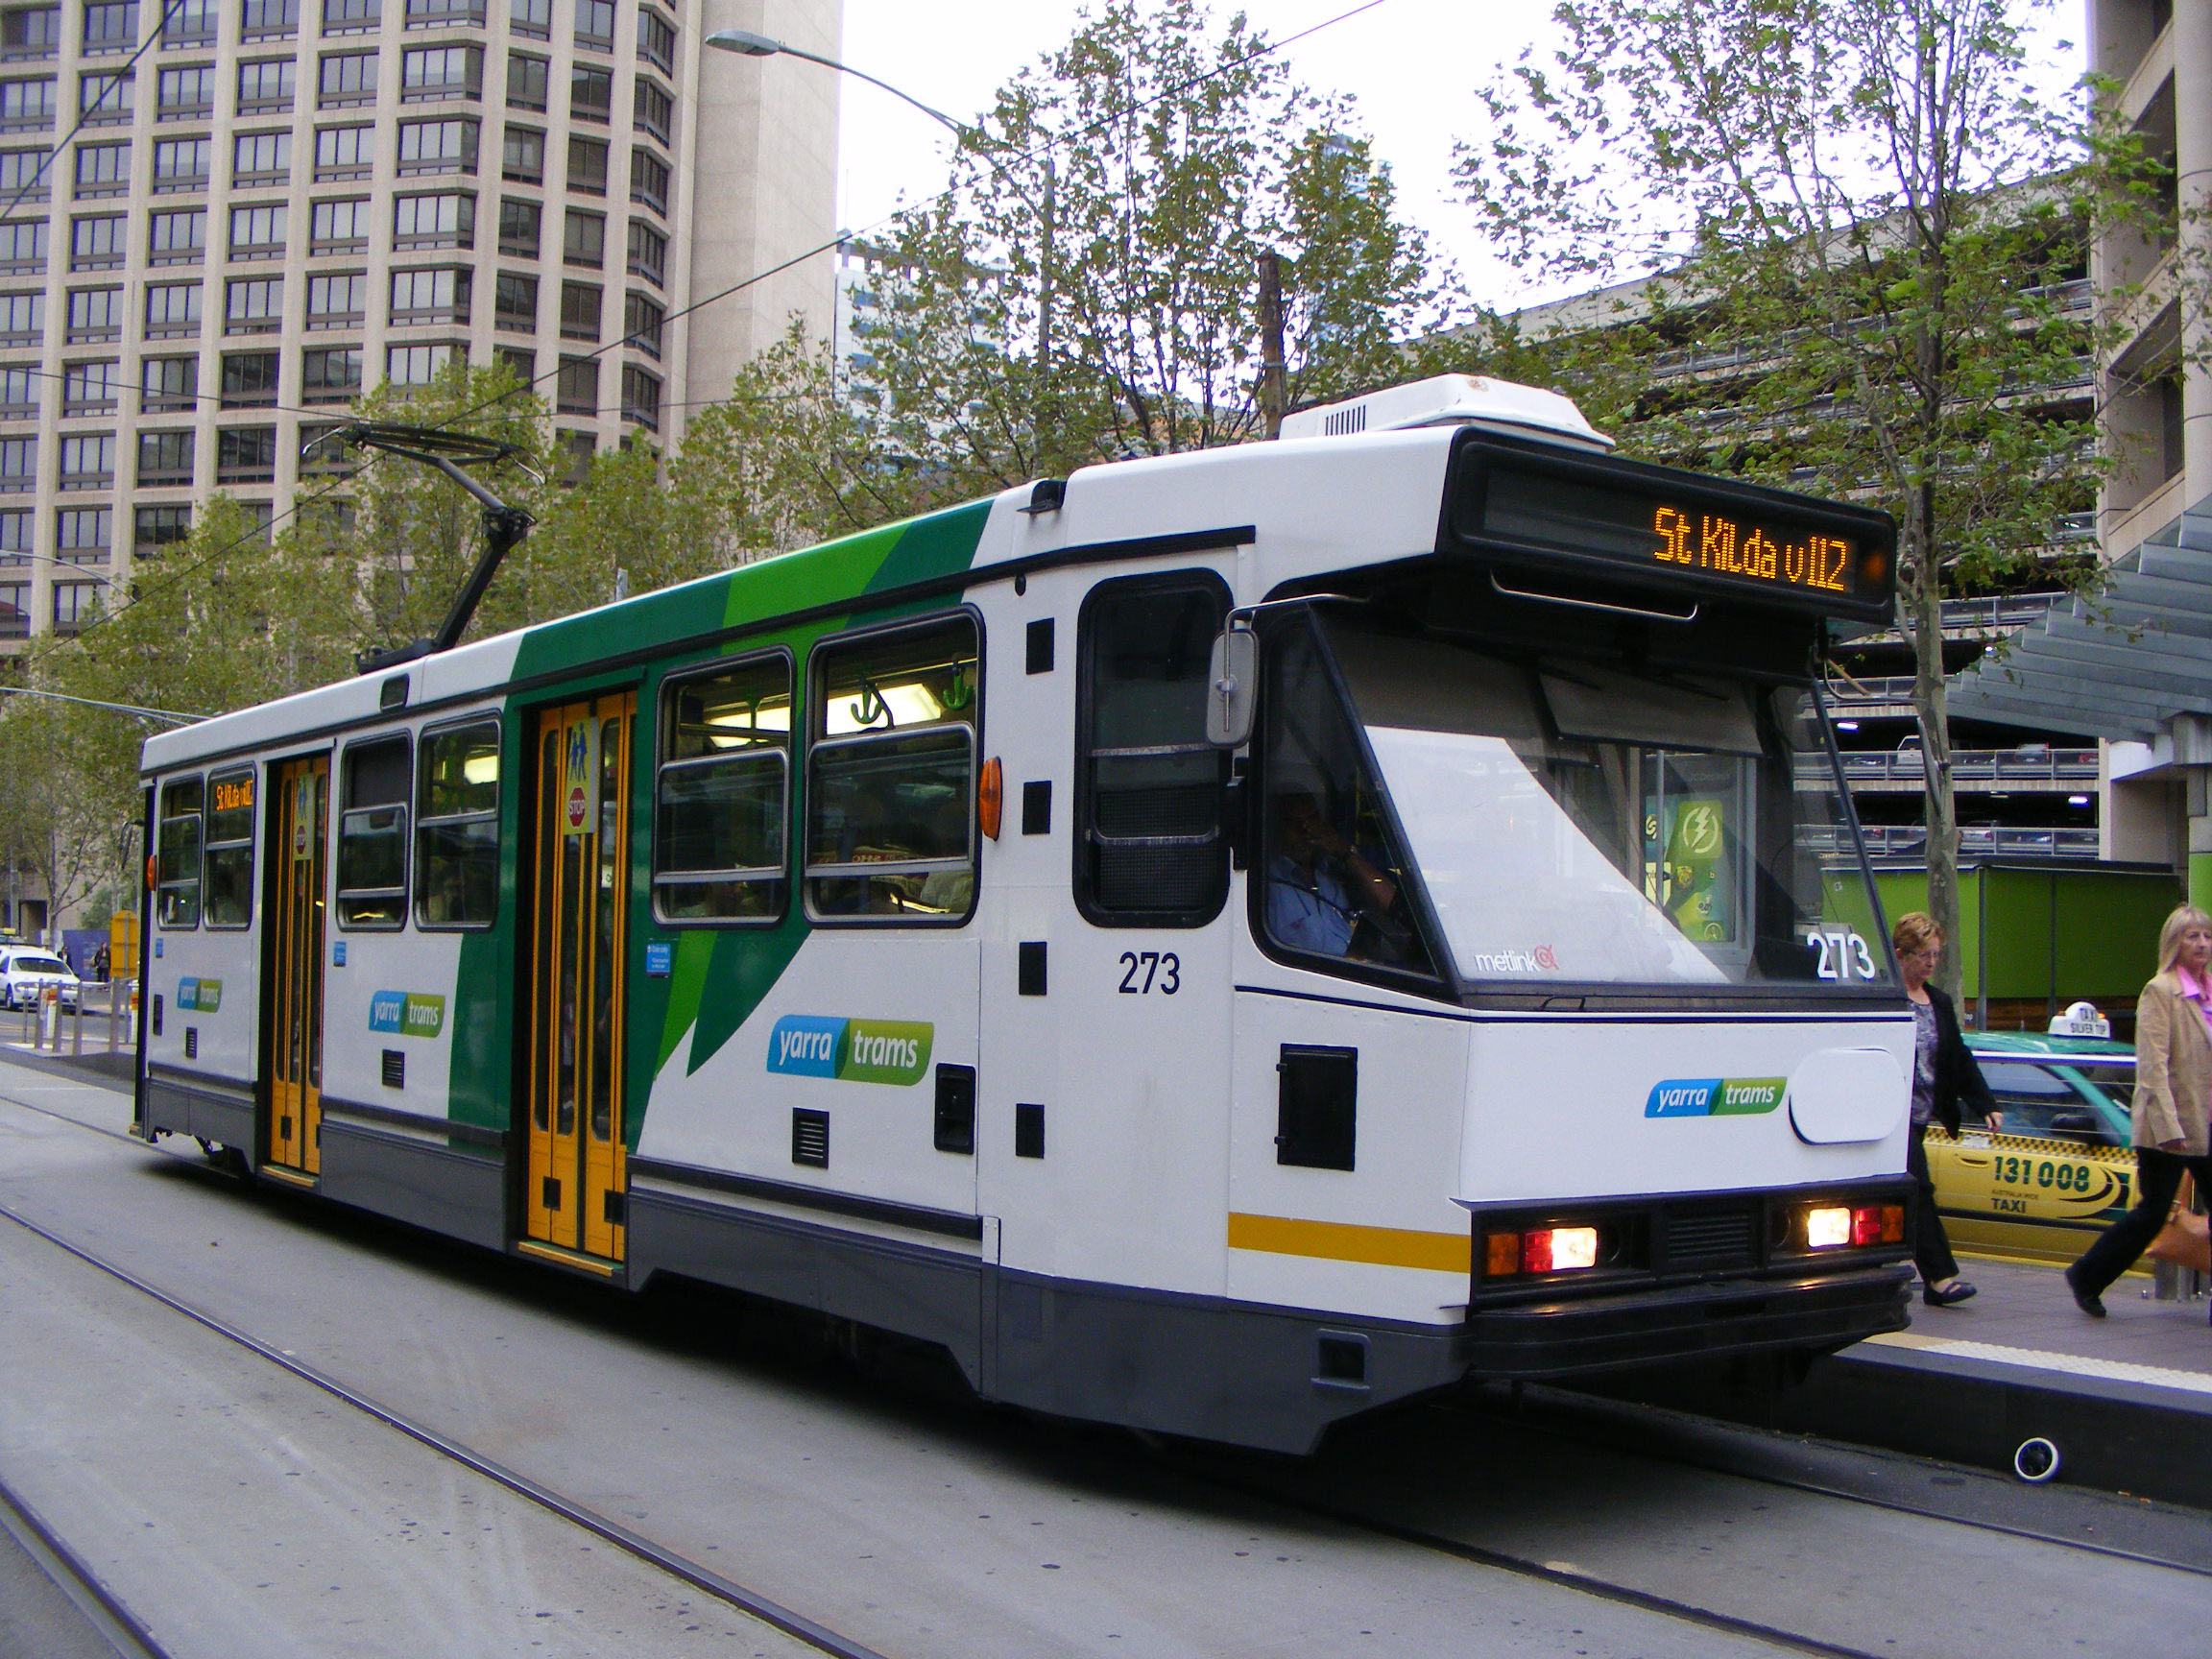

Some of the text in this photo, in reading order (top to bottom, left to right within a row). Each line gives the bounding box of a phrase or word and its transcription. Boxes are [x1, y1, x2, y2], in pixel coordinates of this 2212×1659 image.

[1653, 507, 1847, 591] St Kilda v112
[1118, 950, 1181, 996] 273
[1474, 949, 1541, 972] metlink
[1806, 931, 1876, 979] 273
[373, 999, 439, 1027] yarra trams
[778, 1029, 919, 1069] yarra trams
[1656, 1084, 1775, 1113] yarra trams
[1995, 1156, 2091, 1192] 131 008
[1991, 1197, 2027, 1214] TAXI
